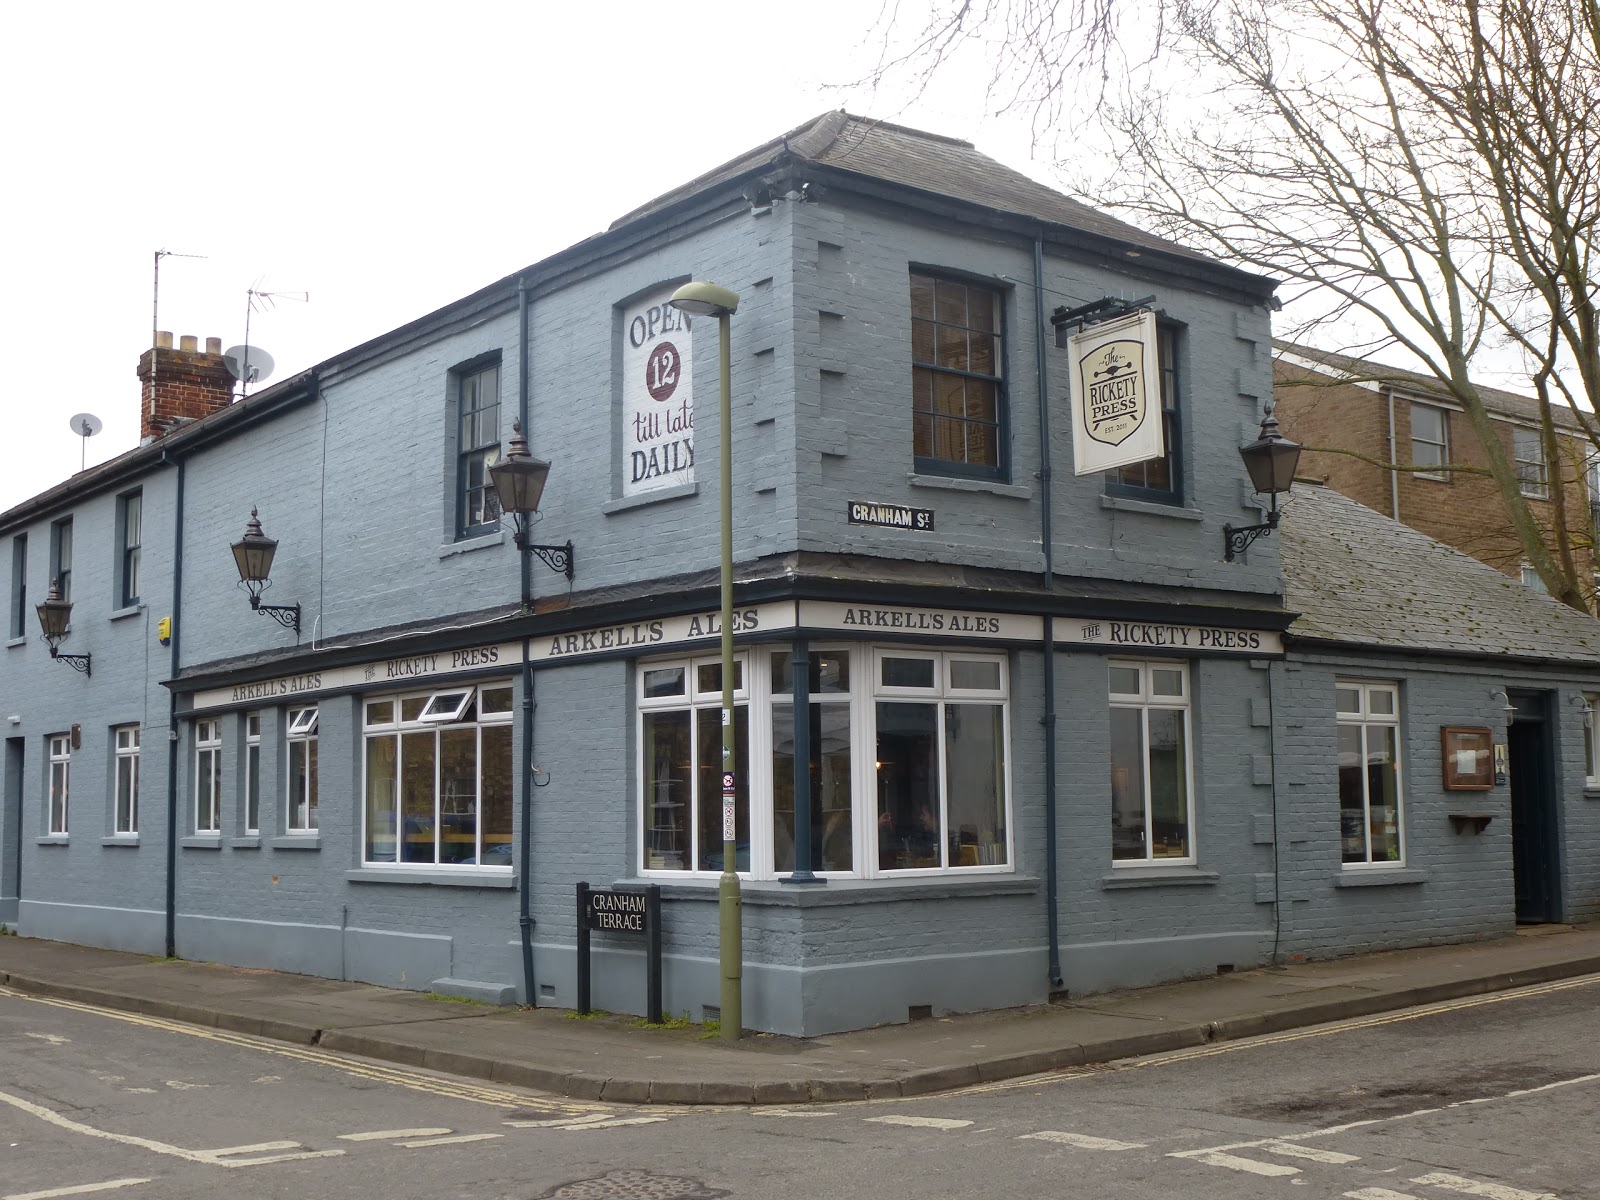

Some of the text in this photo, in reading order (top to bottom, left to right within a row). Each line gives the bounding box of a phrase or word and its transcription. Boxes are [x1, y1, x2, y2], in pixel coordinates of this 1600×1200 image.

[630, 302, 692, 347] OPEN
[652, 351, 675, 390] 12
[1104, 347, 1119, 366] The
[1090, 376, 1137, 406] RICKETY
[632, 399, 694, 443] till late
[1092, 398, 1136, 418] PRESS
[631, 438, 694, 483] DAILY
[852, 504, 912, 526] CRANHAM
[843, 608, 1000, 633] ARKELL'S ALES
[549, 621, 664, 656] ARKELL'S
[1081, 622, 1261, 649] THE RICKETY PRESS
[365, 646, 499, 681] THE RICKETY PRESS
[231, 673, 322, 702] ARKELL'S ALES
[593, 894, 646, 912] CRANHAM
[597, 912, 642, 930] TERRACE
